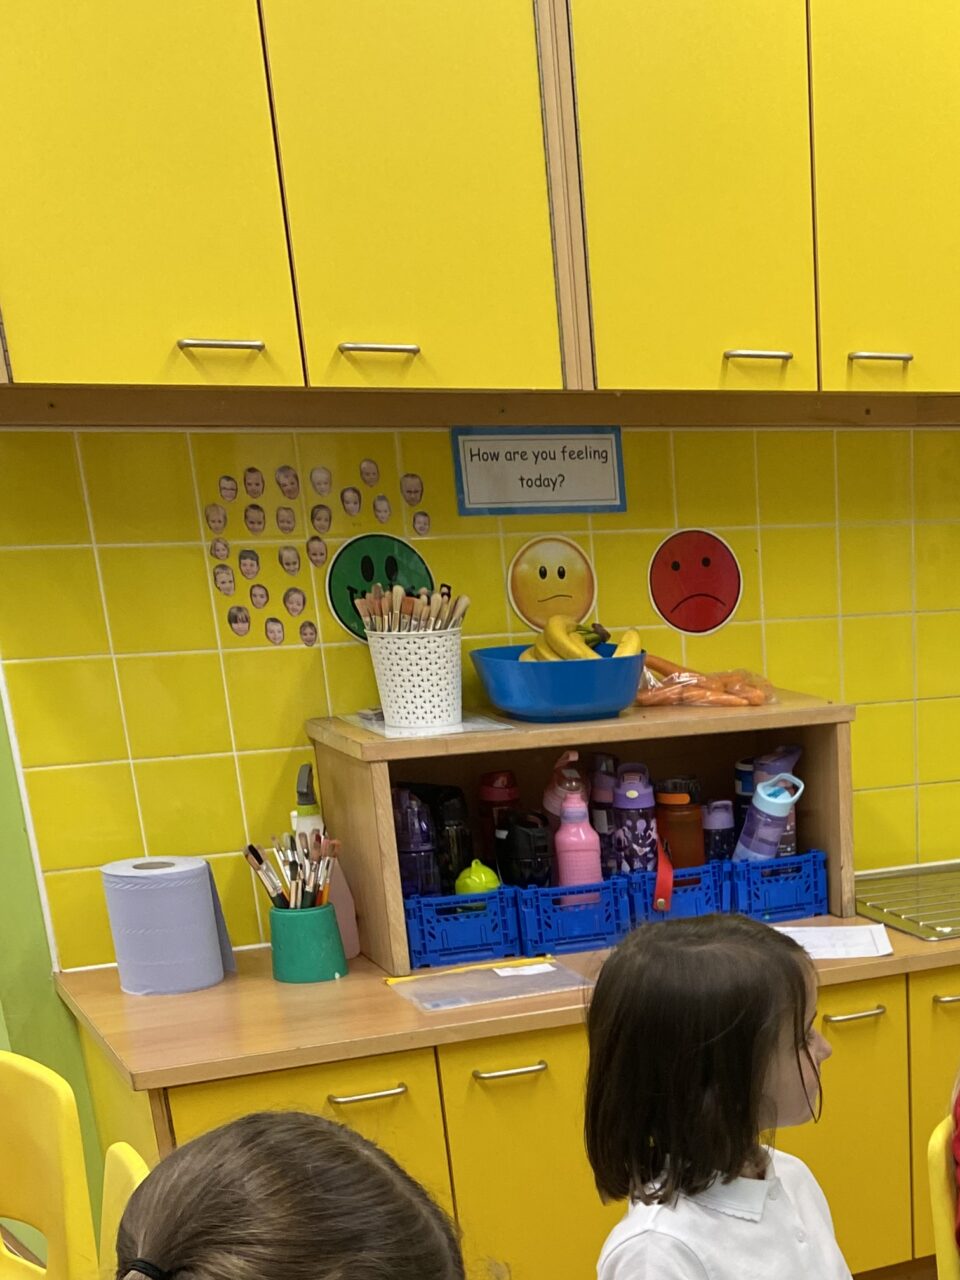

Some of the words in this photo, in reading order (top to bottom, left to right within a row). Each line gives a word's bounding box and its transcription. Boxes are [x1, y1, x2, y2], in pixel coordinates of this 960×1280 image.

[469, 447, 500, 463] How
[504, 450, 529, 462] are
[532, 450, 556, 465] you
[561, 445, 608, 463] feeling
[518, 474, 565, 491] today?
